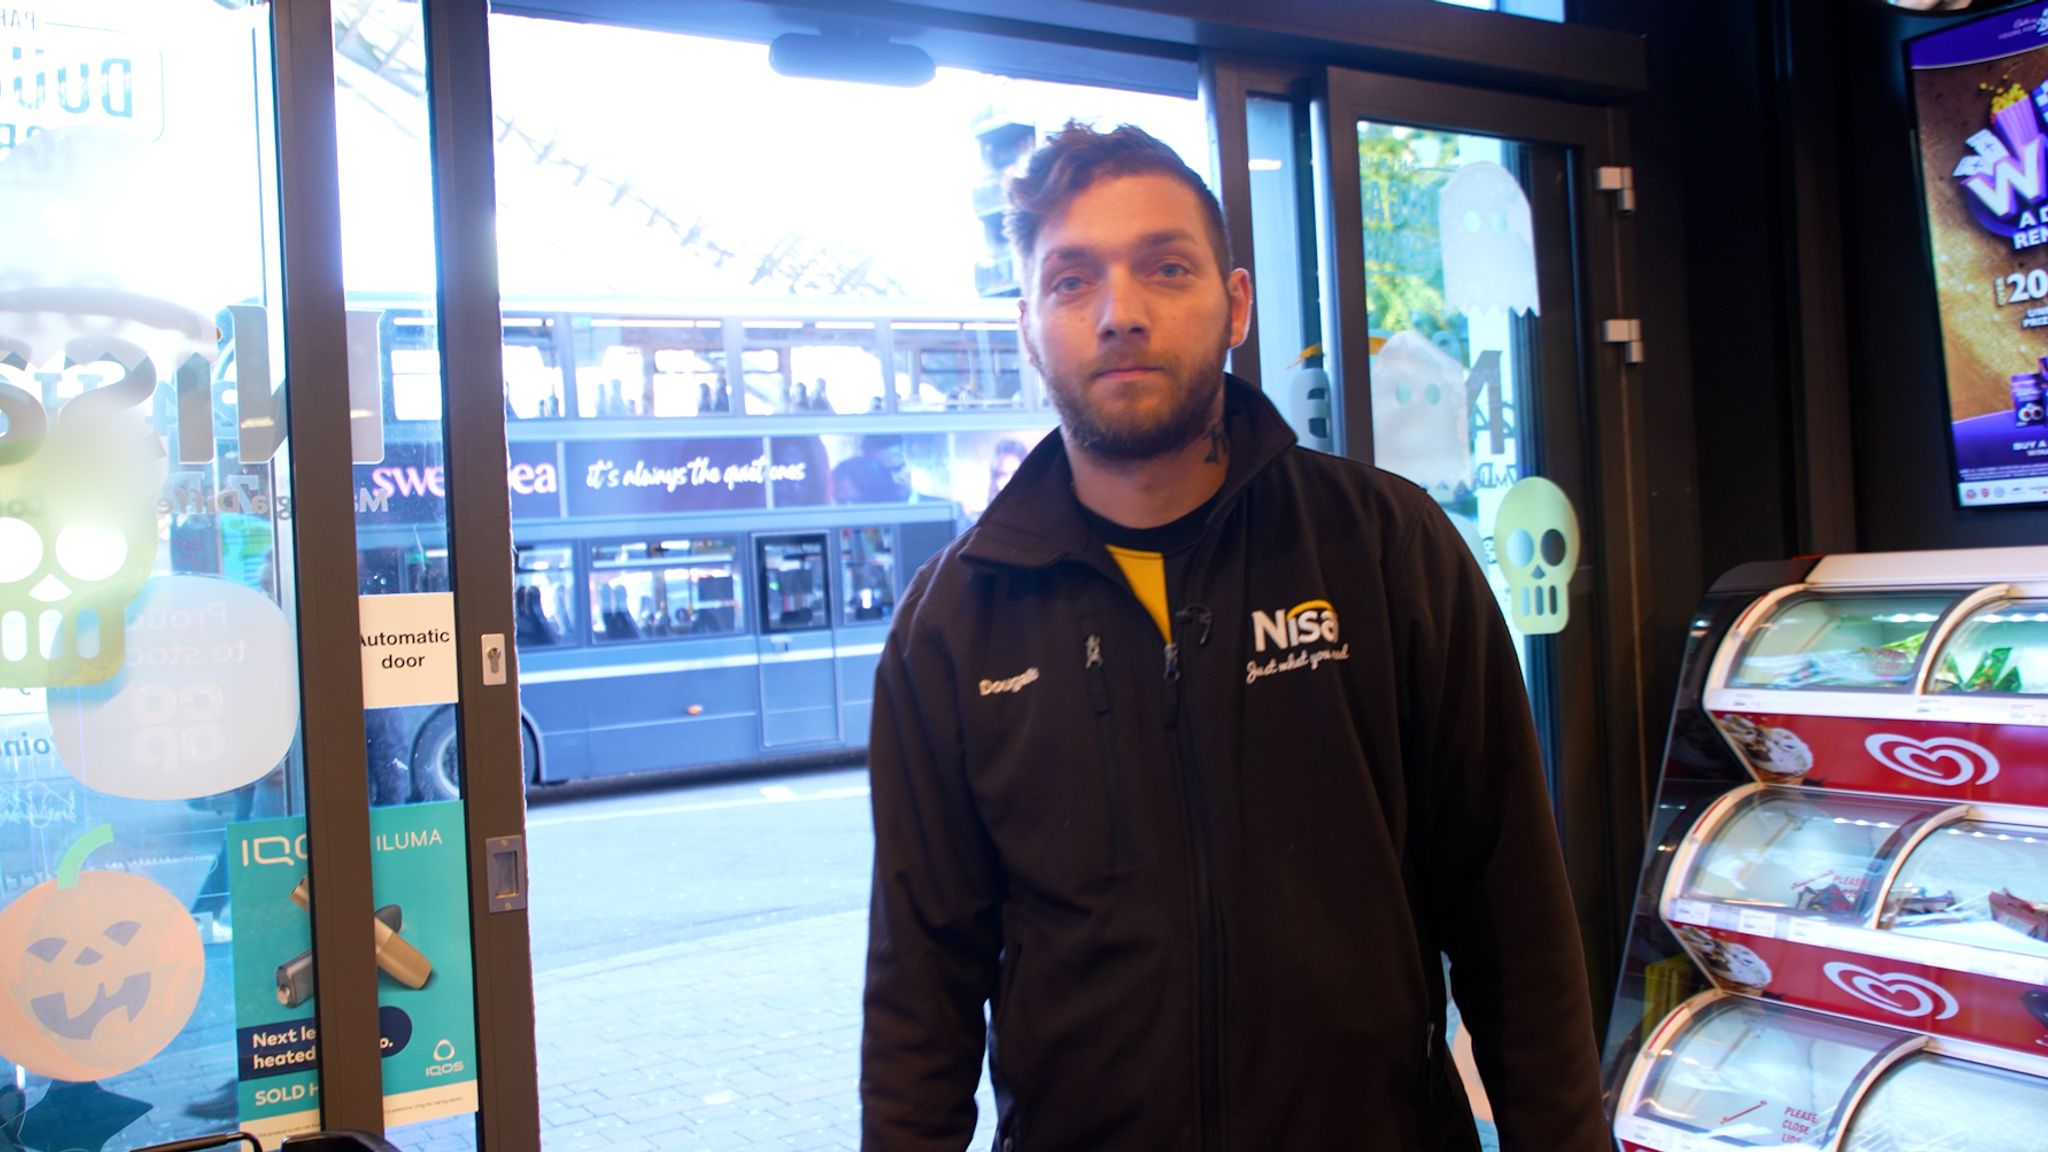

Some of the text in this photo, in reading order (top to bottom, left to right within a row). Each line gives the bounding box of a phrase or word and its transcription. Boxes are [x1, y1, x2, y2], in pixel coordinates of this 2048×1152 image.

[2006, 268, 2048, 304] 20
[622, 460, 687, 493] always
[687, 456, 721, 487] the
[360, 628, 450, 647] Automatic
[1251, 601, 1339, 652] Nisa
[381, 654, 426, 669] door
[1246, 657, 1277, 684] Just
[1278, 649, 1309, 672] what
[375, 828, 443, 852] ILUMA
[252, 1026, 316, 1048] Next le
[253, 1045, 316, 1069] heated
[425, 1061, 465, 1077] IQOS
[254, 1084, 305, 1107] SOLD
[1784, 1106, 1819, 1124] PLEASE
[1782, 1120, 1811, 1135] CLOSE
